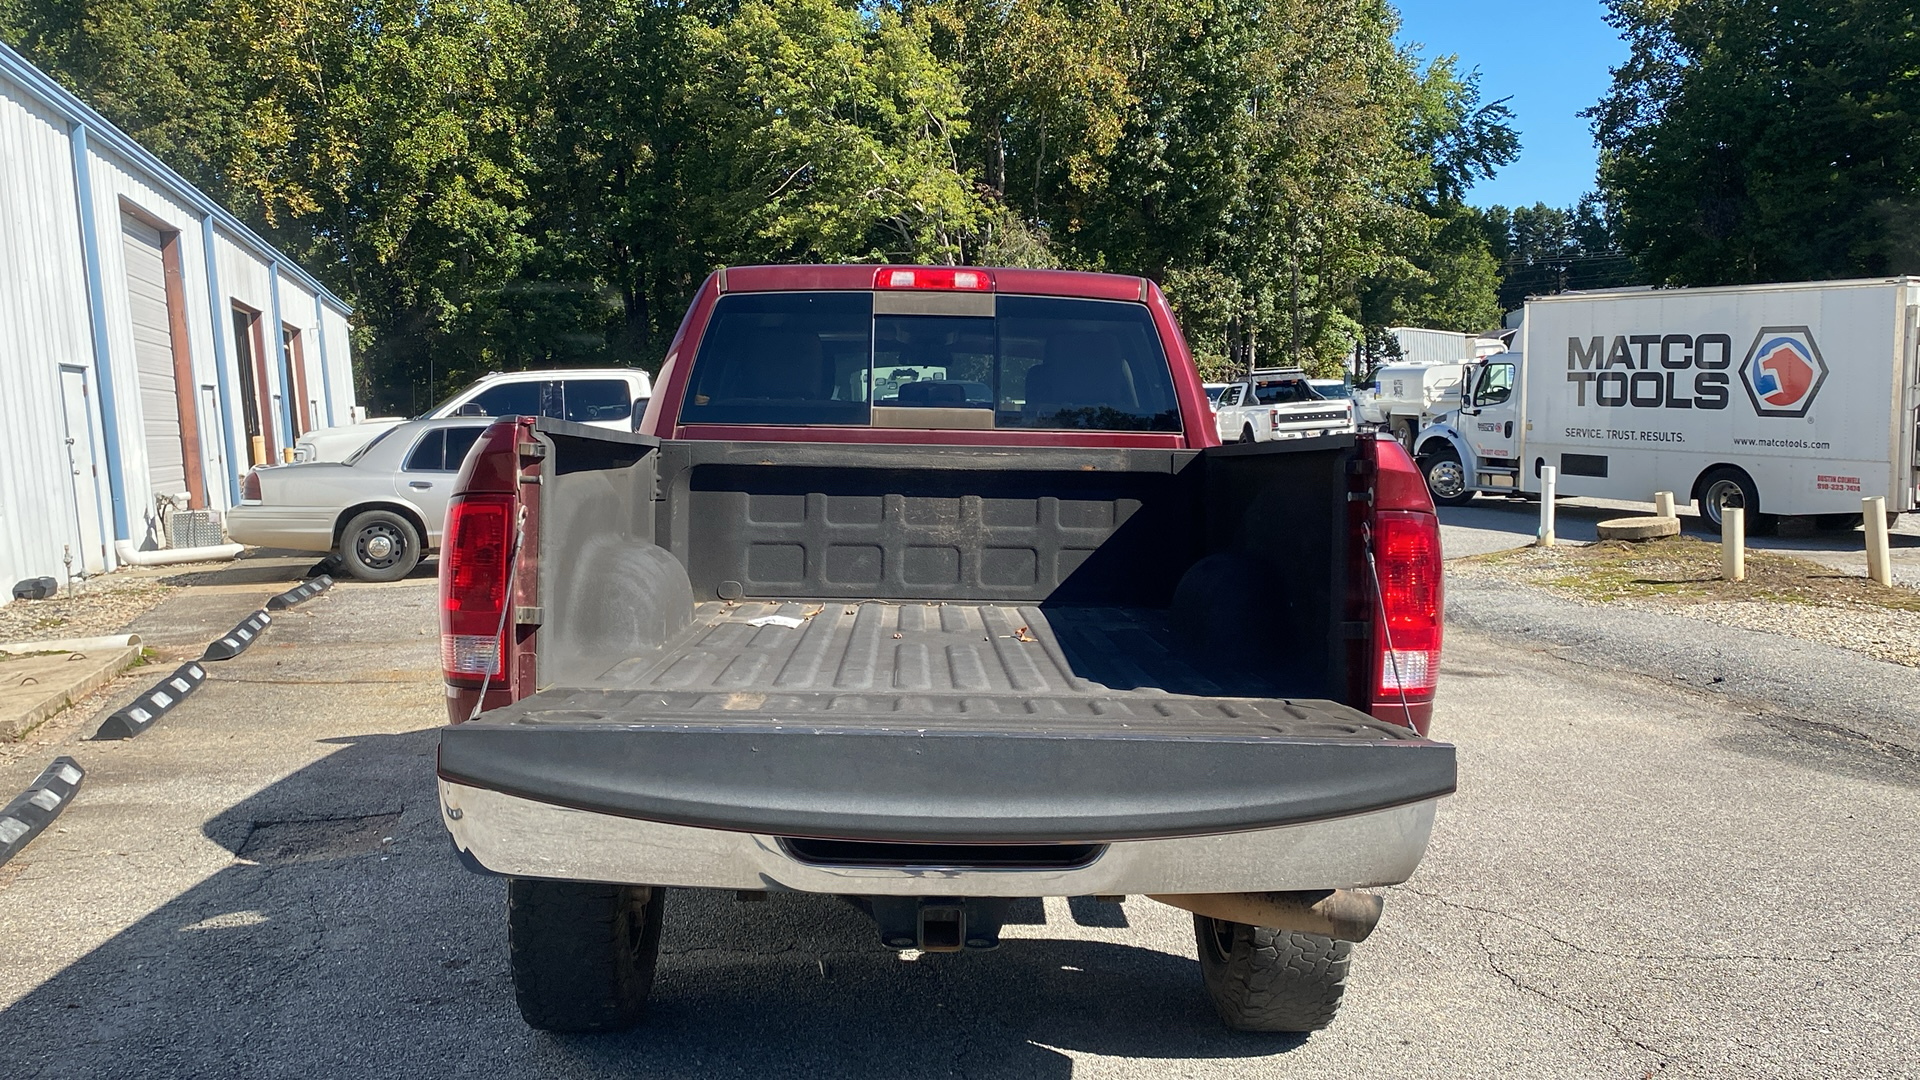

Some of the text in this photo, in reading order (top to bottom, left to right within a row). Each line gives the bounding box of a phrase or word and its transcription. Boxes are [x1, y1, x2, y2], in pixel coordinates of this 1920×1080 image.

[1567, 334, 1732, 370] MATCO
[1567, 371, 1730, 410] TOOLS
[1565, 427, 1686, 443] SERVICE. TRUST. RESULTS.
[1733, 438, 1831, 450] www.matcotools.com
